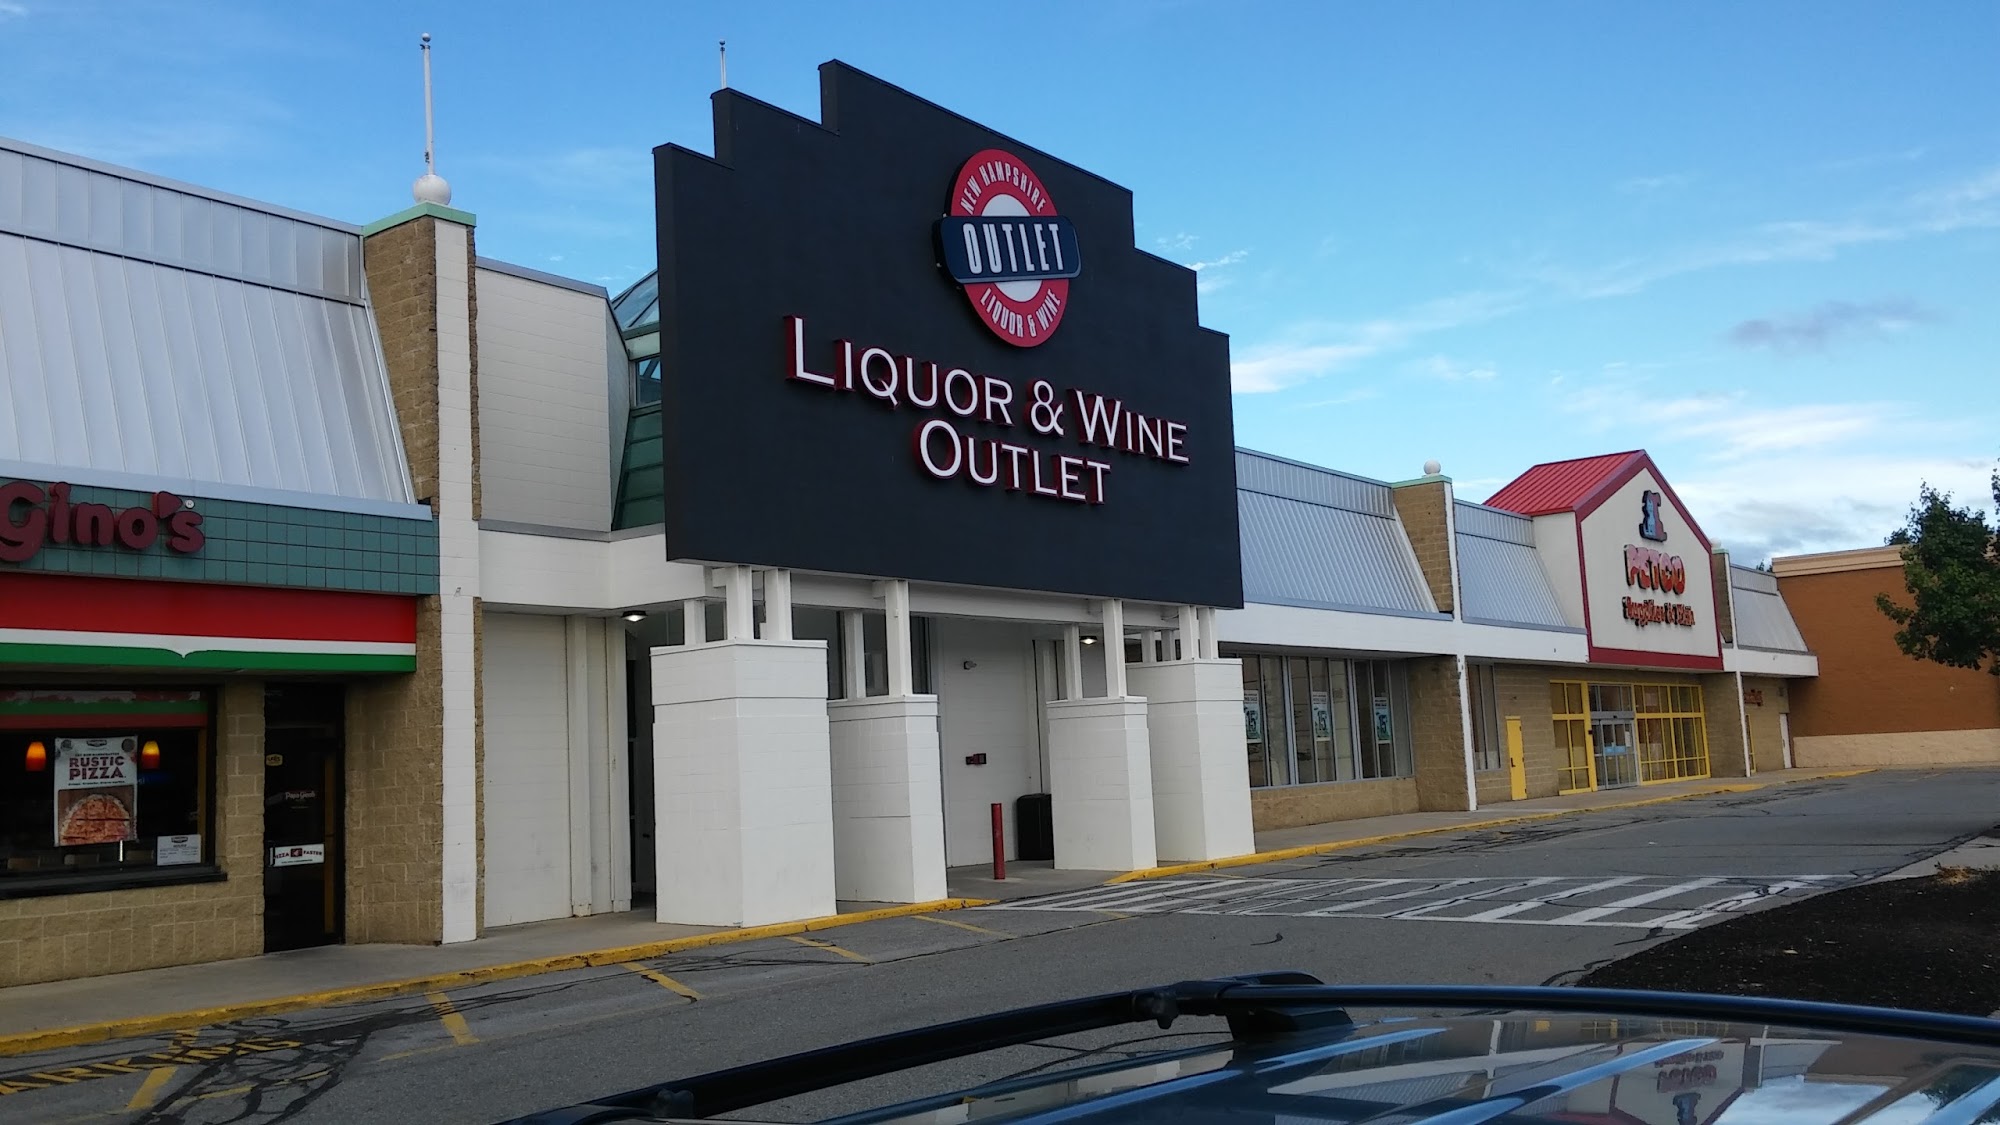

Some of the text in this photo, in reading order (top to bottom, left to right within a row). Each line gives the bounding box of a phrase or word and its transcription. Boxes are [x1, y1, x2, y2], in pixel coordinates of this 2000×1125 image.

[960, 160, 1047, 215] NEW HAMPSHIRE
[963, 223, 1064, 275] OUTLET
[980, 288, 1061, 338] LIQUOR & WINE
[784, 315, 1190, 467] LIQUOR & WINE
[915, 419, 1111, 505] OUTLET
[0, 481, 206, 562] Gino's
[1624, 543, 1686, 595] PETCO
[69, 756, 125, 768] RUSTIC
[69, 767, 124, 781] PIZZA
